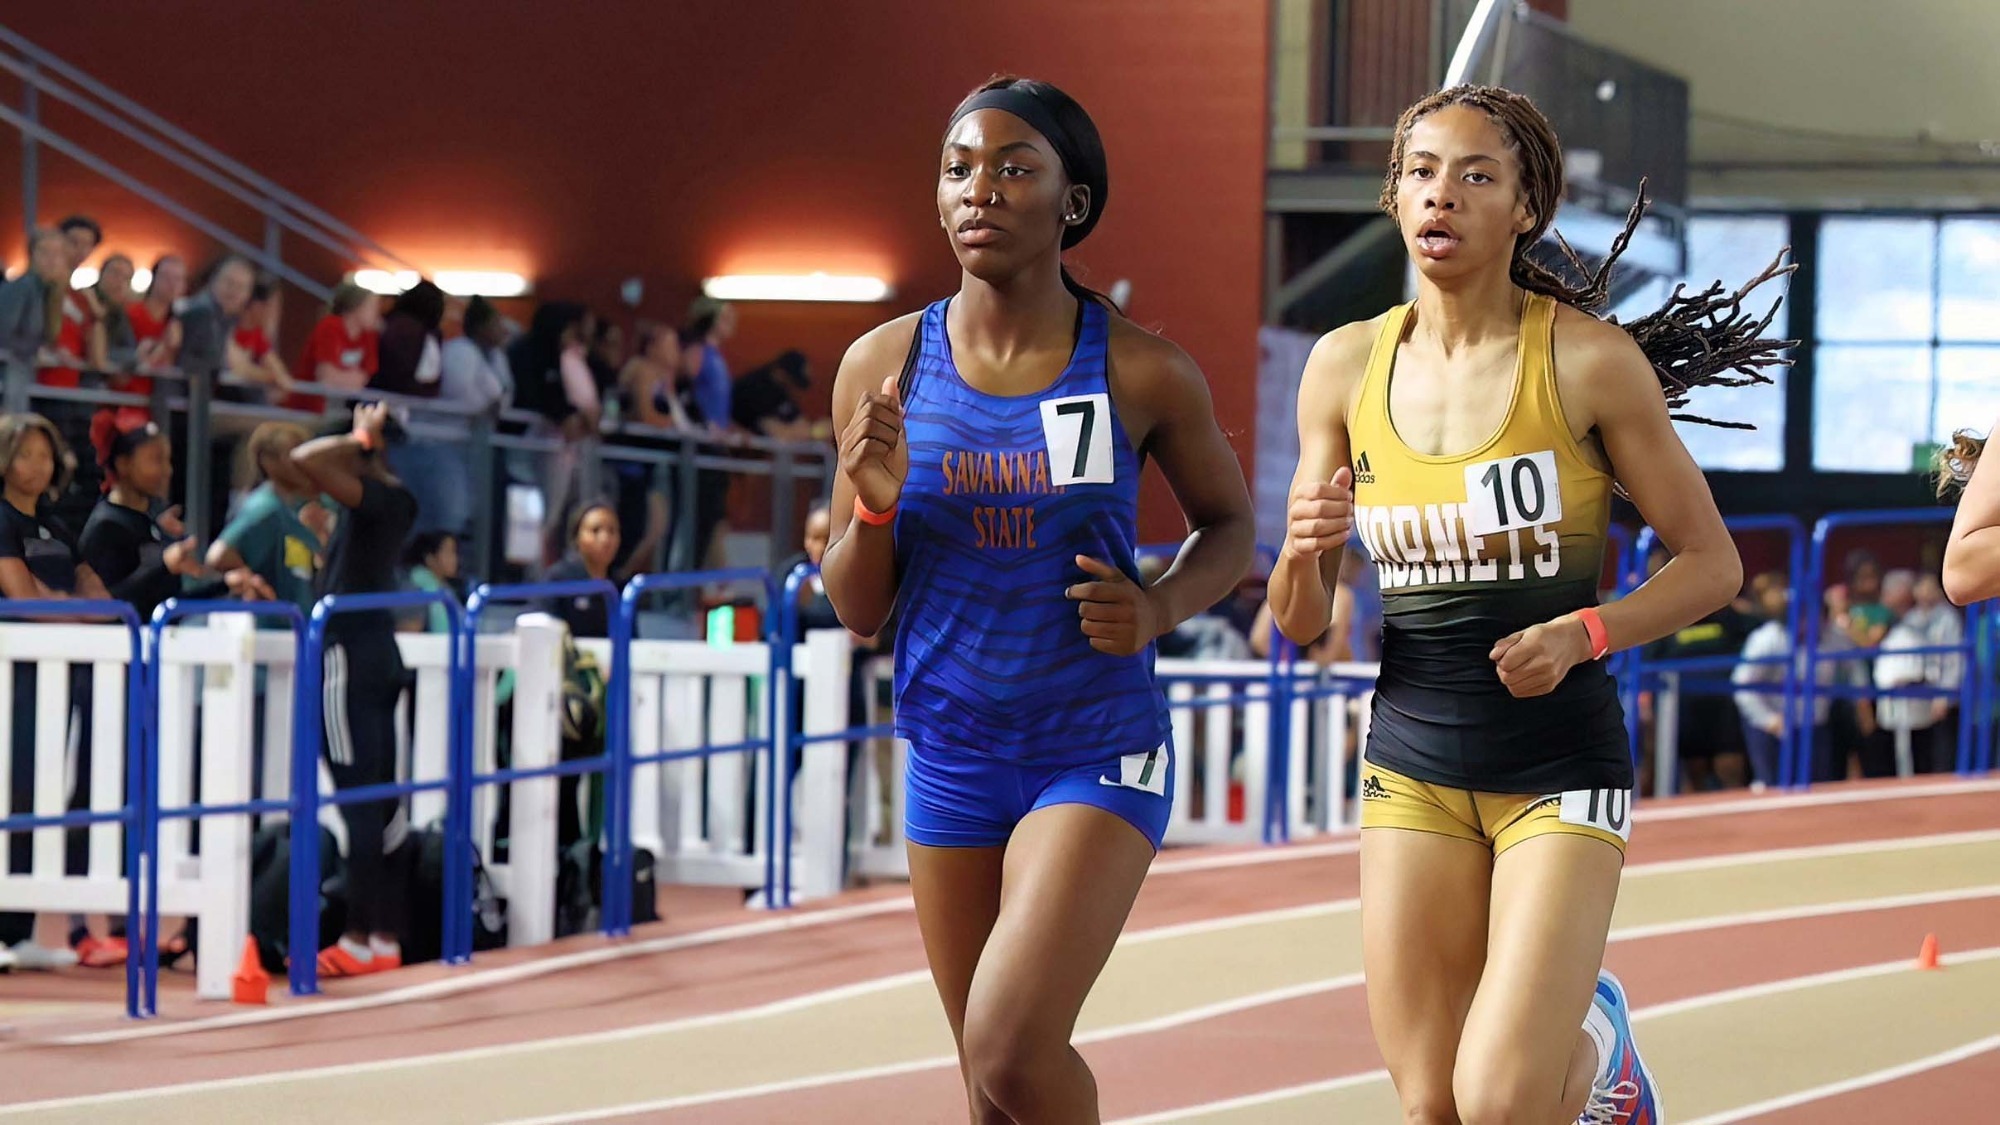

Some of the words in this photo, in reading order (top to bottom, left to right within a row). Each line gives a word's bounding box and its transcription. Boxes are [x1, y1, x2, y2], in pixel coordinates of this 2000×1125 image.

[1056, 400, 1095, 478] 7
[942, 451, 1066, 495] SAVANNA
[1480, 457, 1545, 527] 10
[972, 506, 1036, 548] STATE
